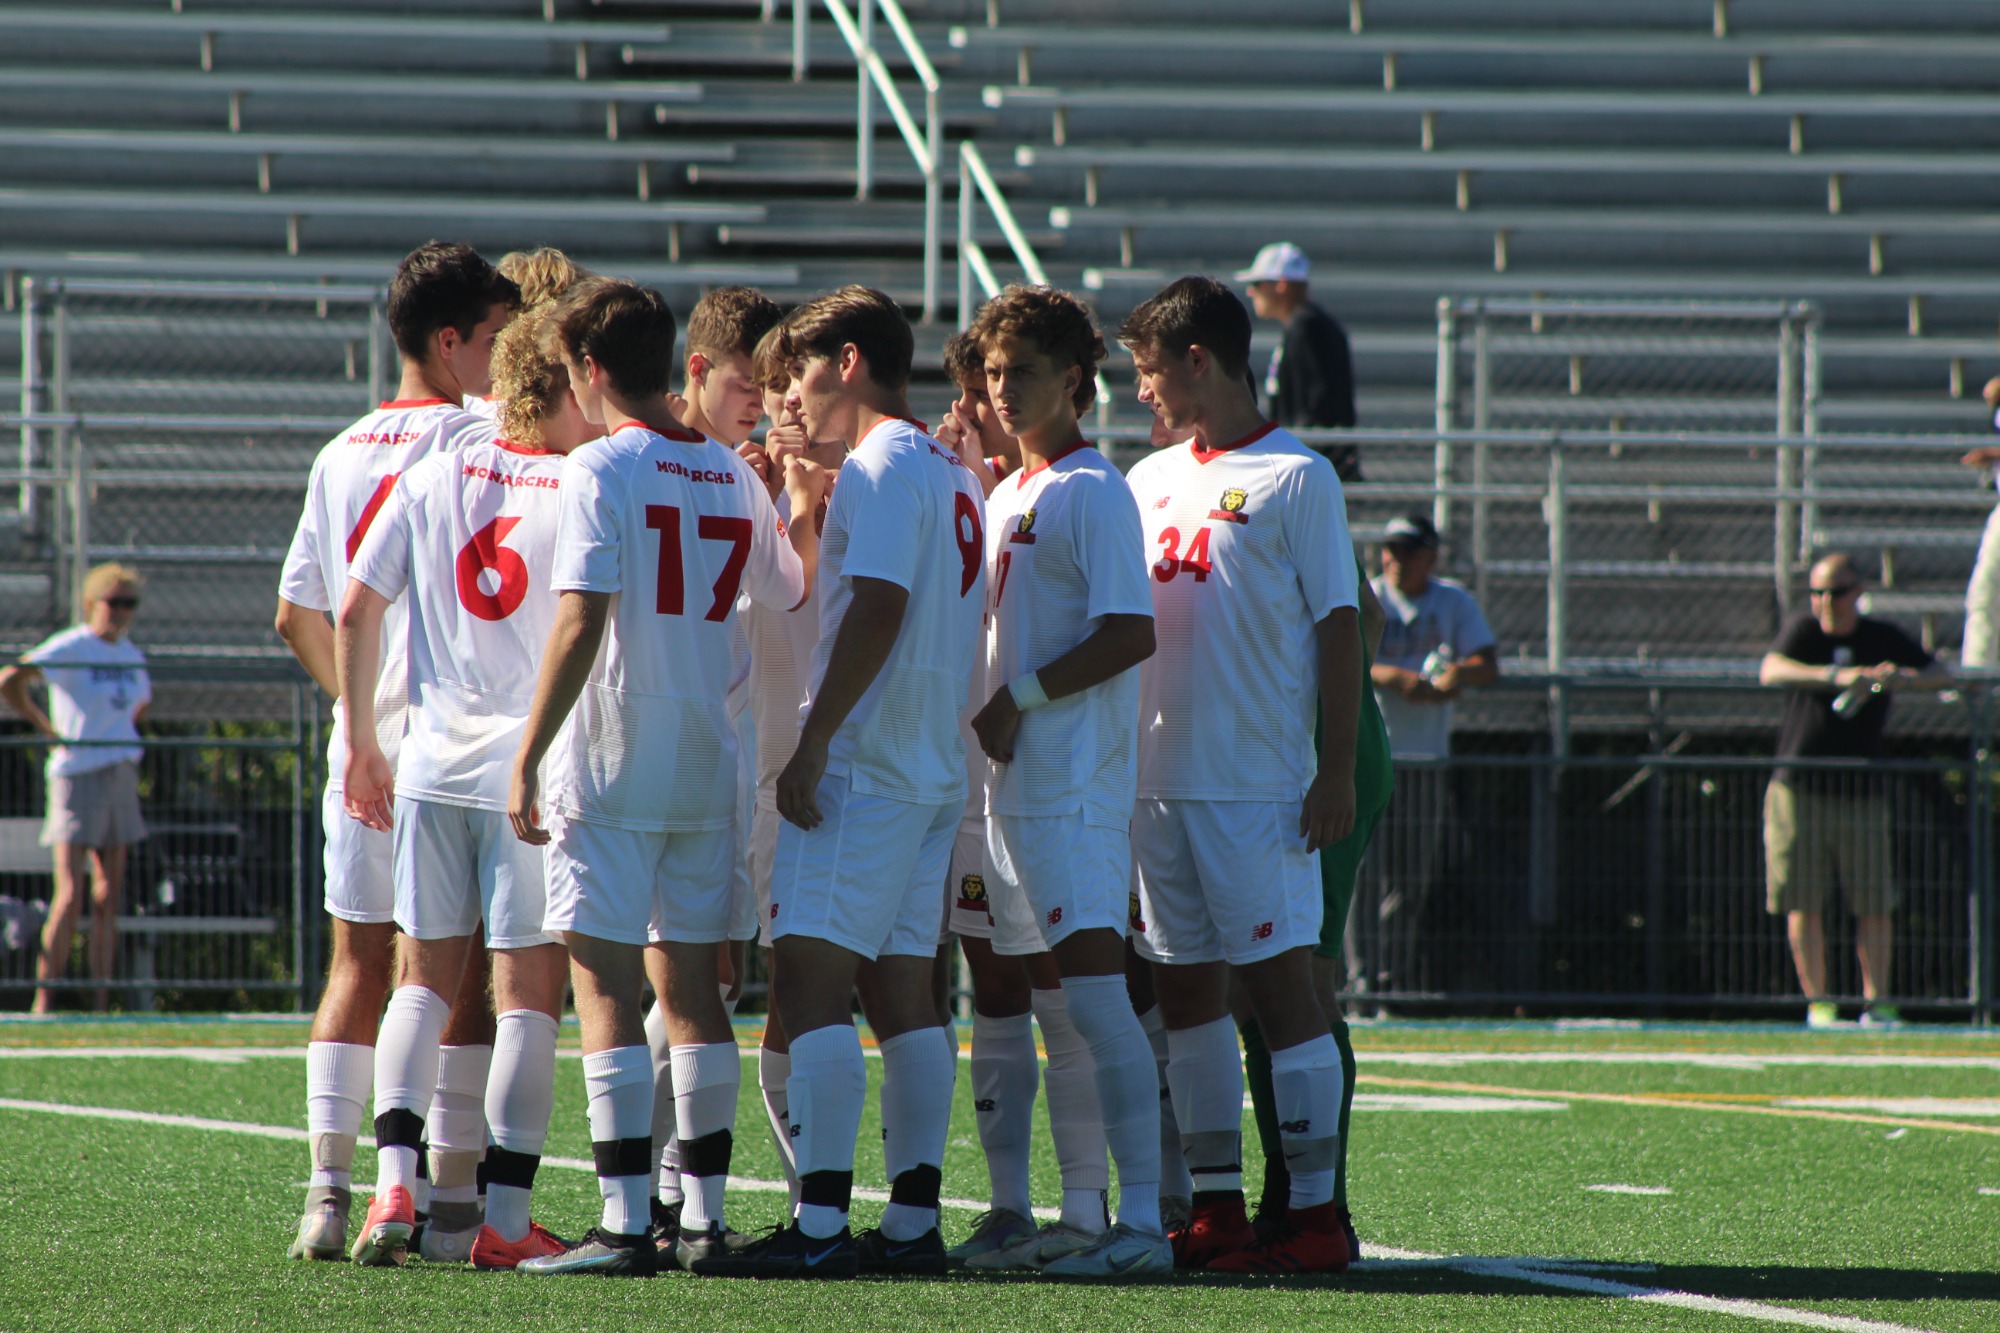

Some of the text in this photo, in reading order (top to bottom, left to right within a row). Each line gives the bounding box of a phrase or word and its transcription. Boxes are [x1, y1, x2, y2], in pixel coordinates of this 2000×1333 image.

[463, 465, 559, 489] MONARCHS
[456, 517, 529, 621] 6
[645, 504, 752, 622] 17
[1154, 526, 1213, 583] 34
